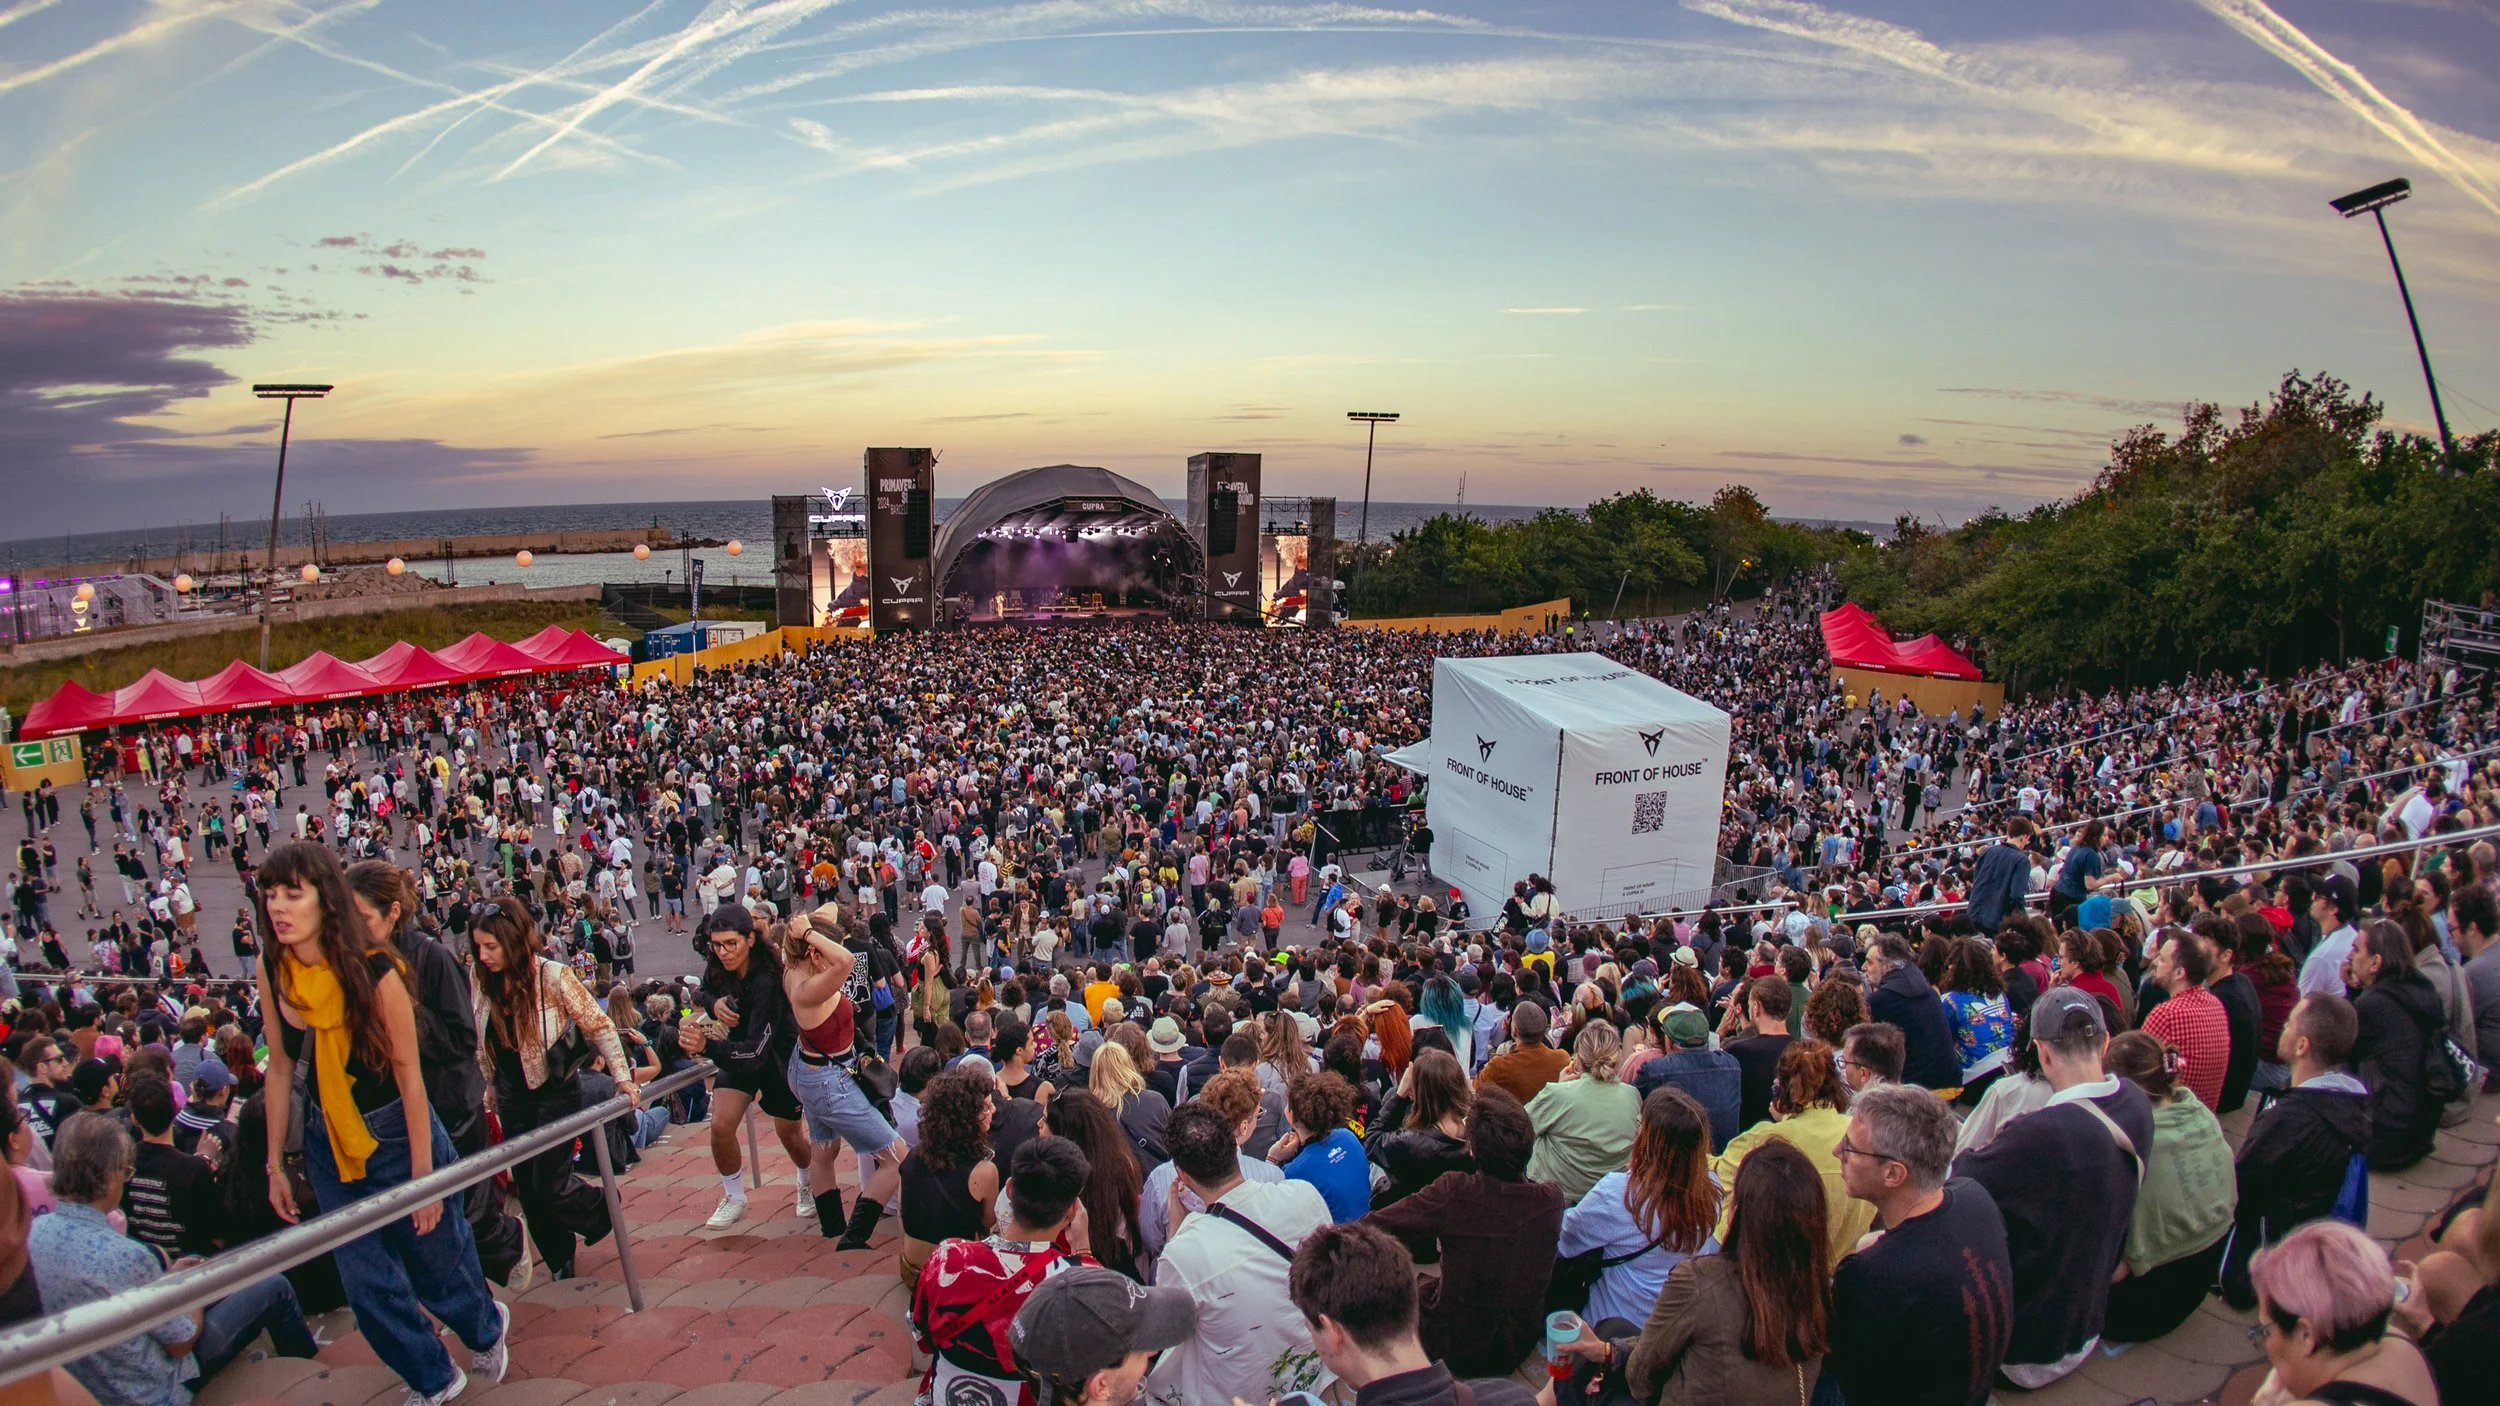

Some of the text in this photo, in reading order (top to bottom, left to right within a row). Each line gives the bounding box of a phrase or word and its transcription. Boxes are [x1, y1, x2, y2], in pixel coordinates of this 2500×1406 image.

[808, 514, 866, 523] CUPRA
[1560, 675, 1579, 683] OF
[1447, 757, 1475, 779] FRONT
[1476, 771, 1489, 785] OF
[1595, 769, 1640, 786] FRONT
[1643, 767, 1659, 782] OF
[987, 1271, 1029, 1306] ALASKA
